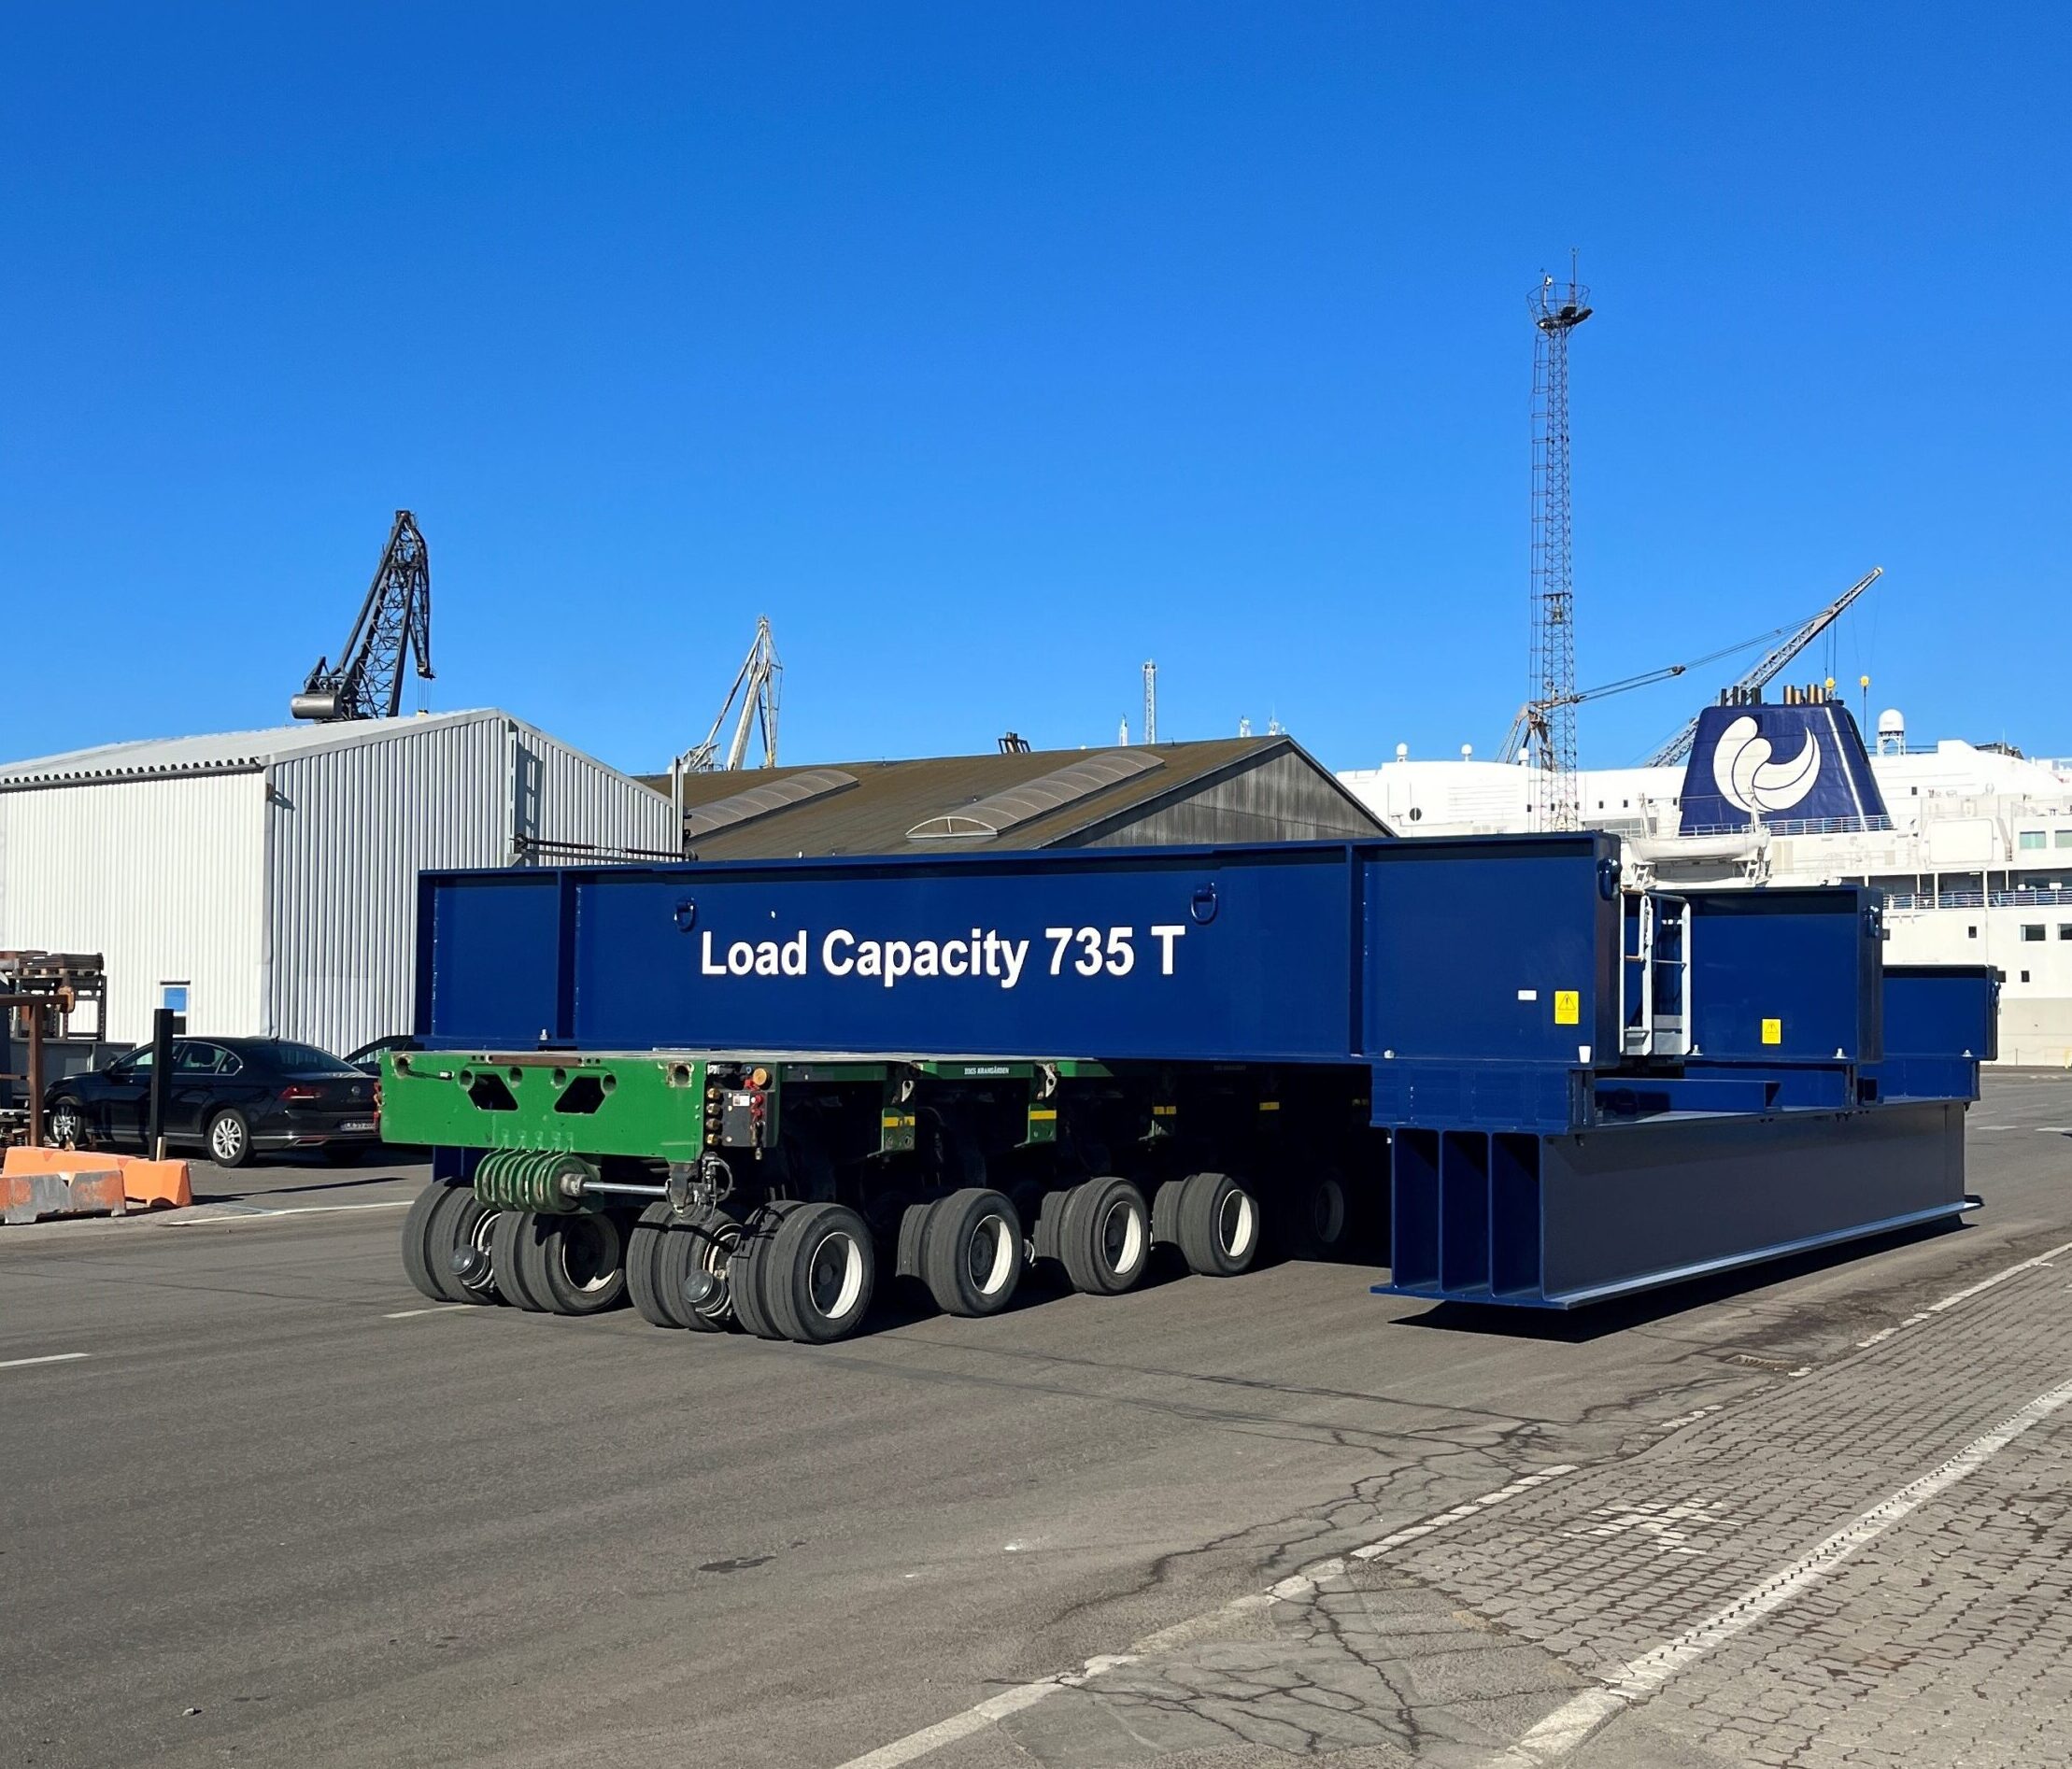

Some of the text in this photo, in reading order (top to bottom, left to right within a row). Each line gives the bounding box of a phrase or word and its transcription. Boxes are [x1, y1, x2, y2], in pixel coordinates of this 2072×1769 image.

[702, 925, 1186, 989] Load Capacity 735 T
